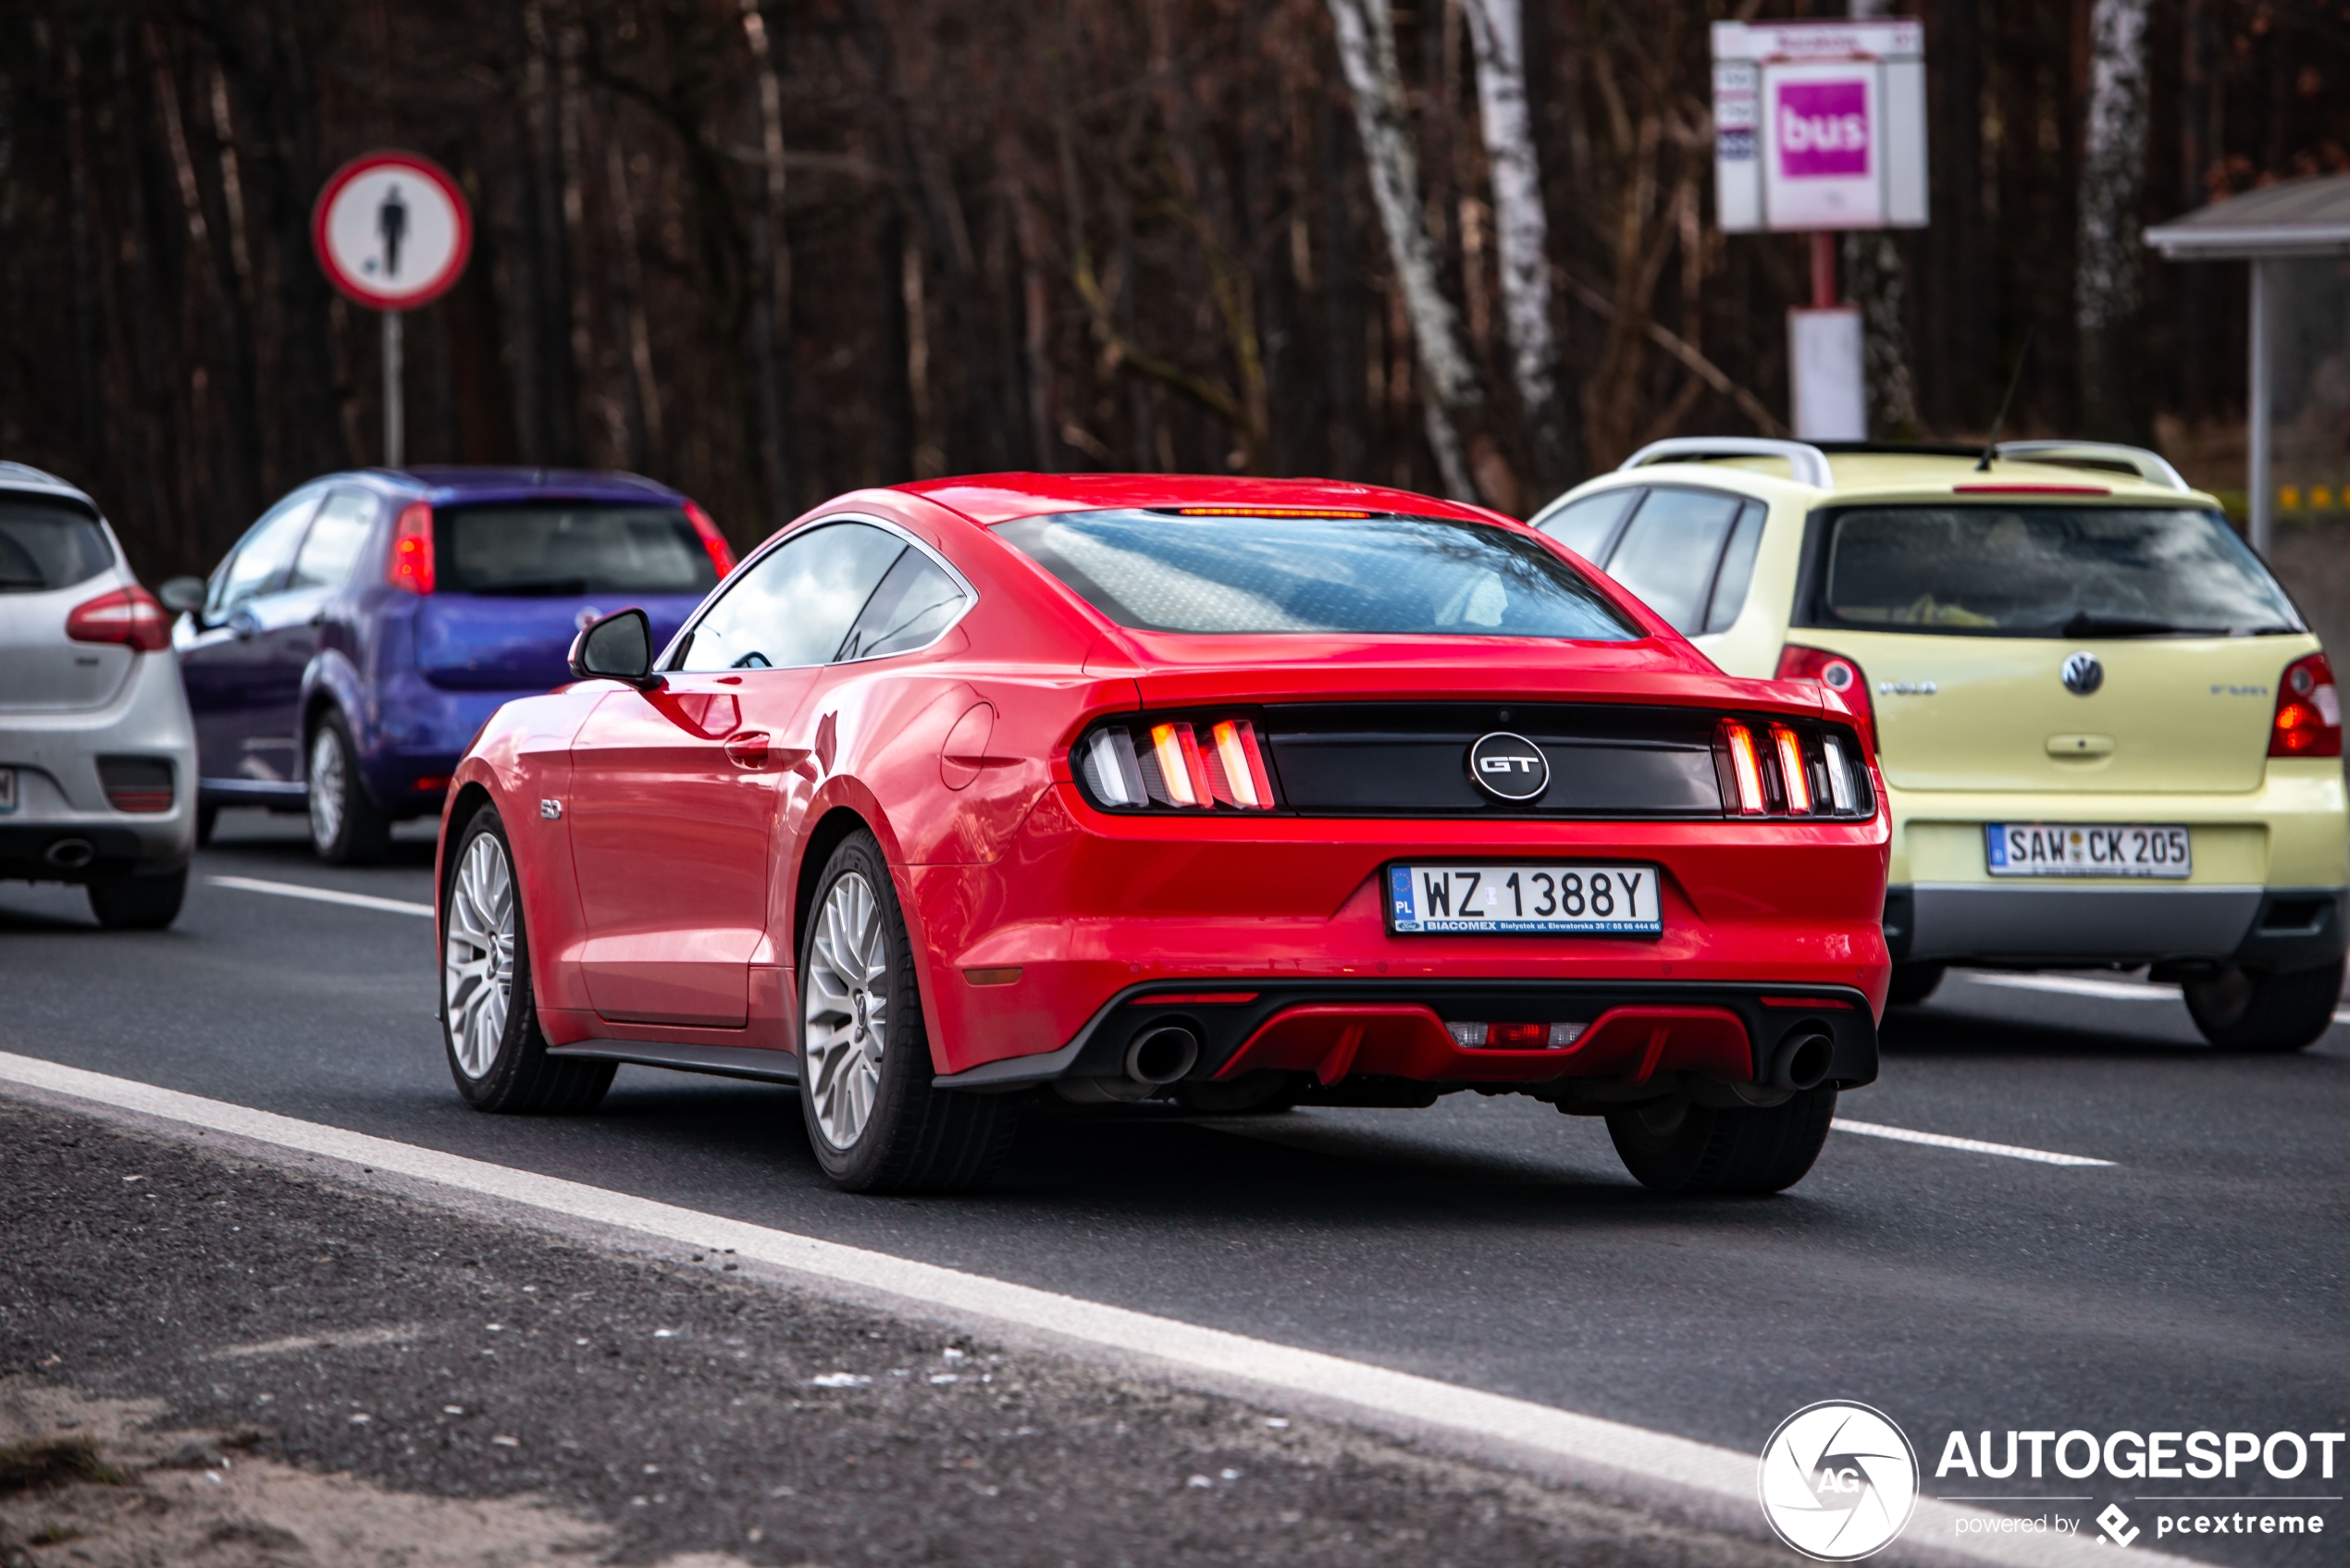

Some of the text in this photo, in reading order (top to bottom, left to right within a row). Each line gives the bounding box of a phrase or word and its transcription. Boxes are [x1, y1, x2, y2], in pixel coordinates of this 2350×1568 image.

[1782, 105, 1865, 152] bus
[1879, 681, 1937, 696] POLO
[1479, 756, 1540, 772] GT
[2010, 829, 2186, 864] SAW CK 205
[1423, 871, 1642, 919] WZ 1388Y
[1395, 900, 1413, 914] PL
[1427, 920, 1497, 931] BIACOMEX
[1500, 921, 1536, 931] Białystok
